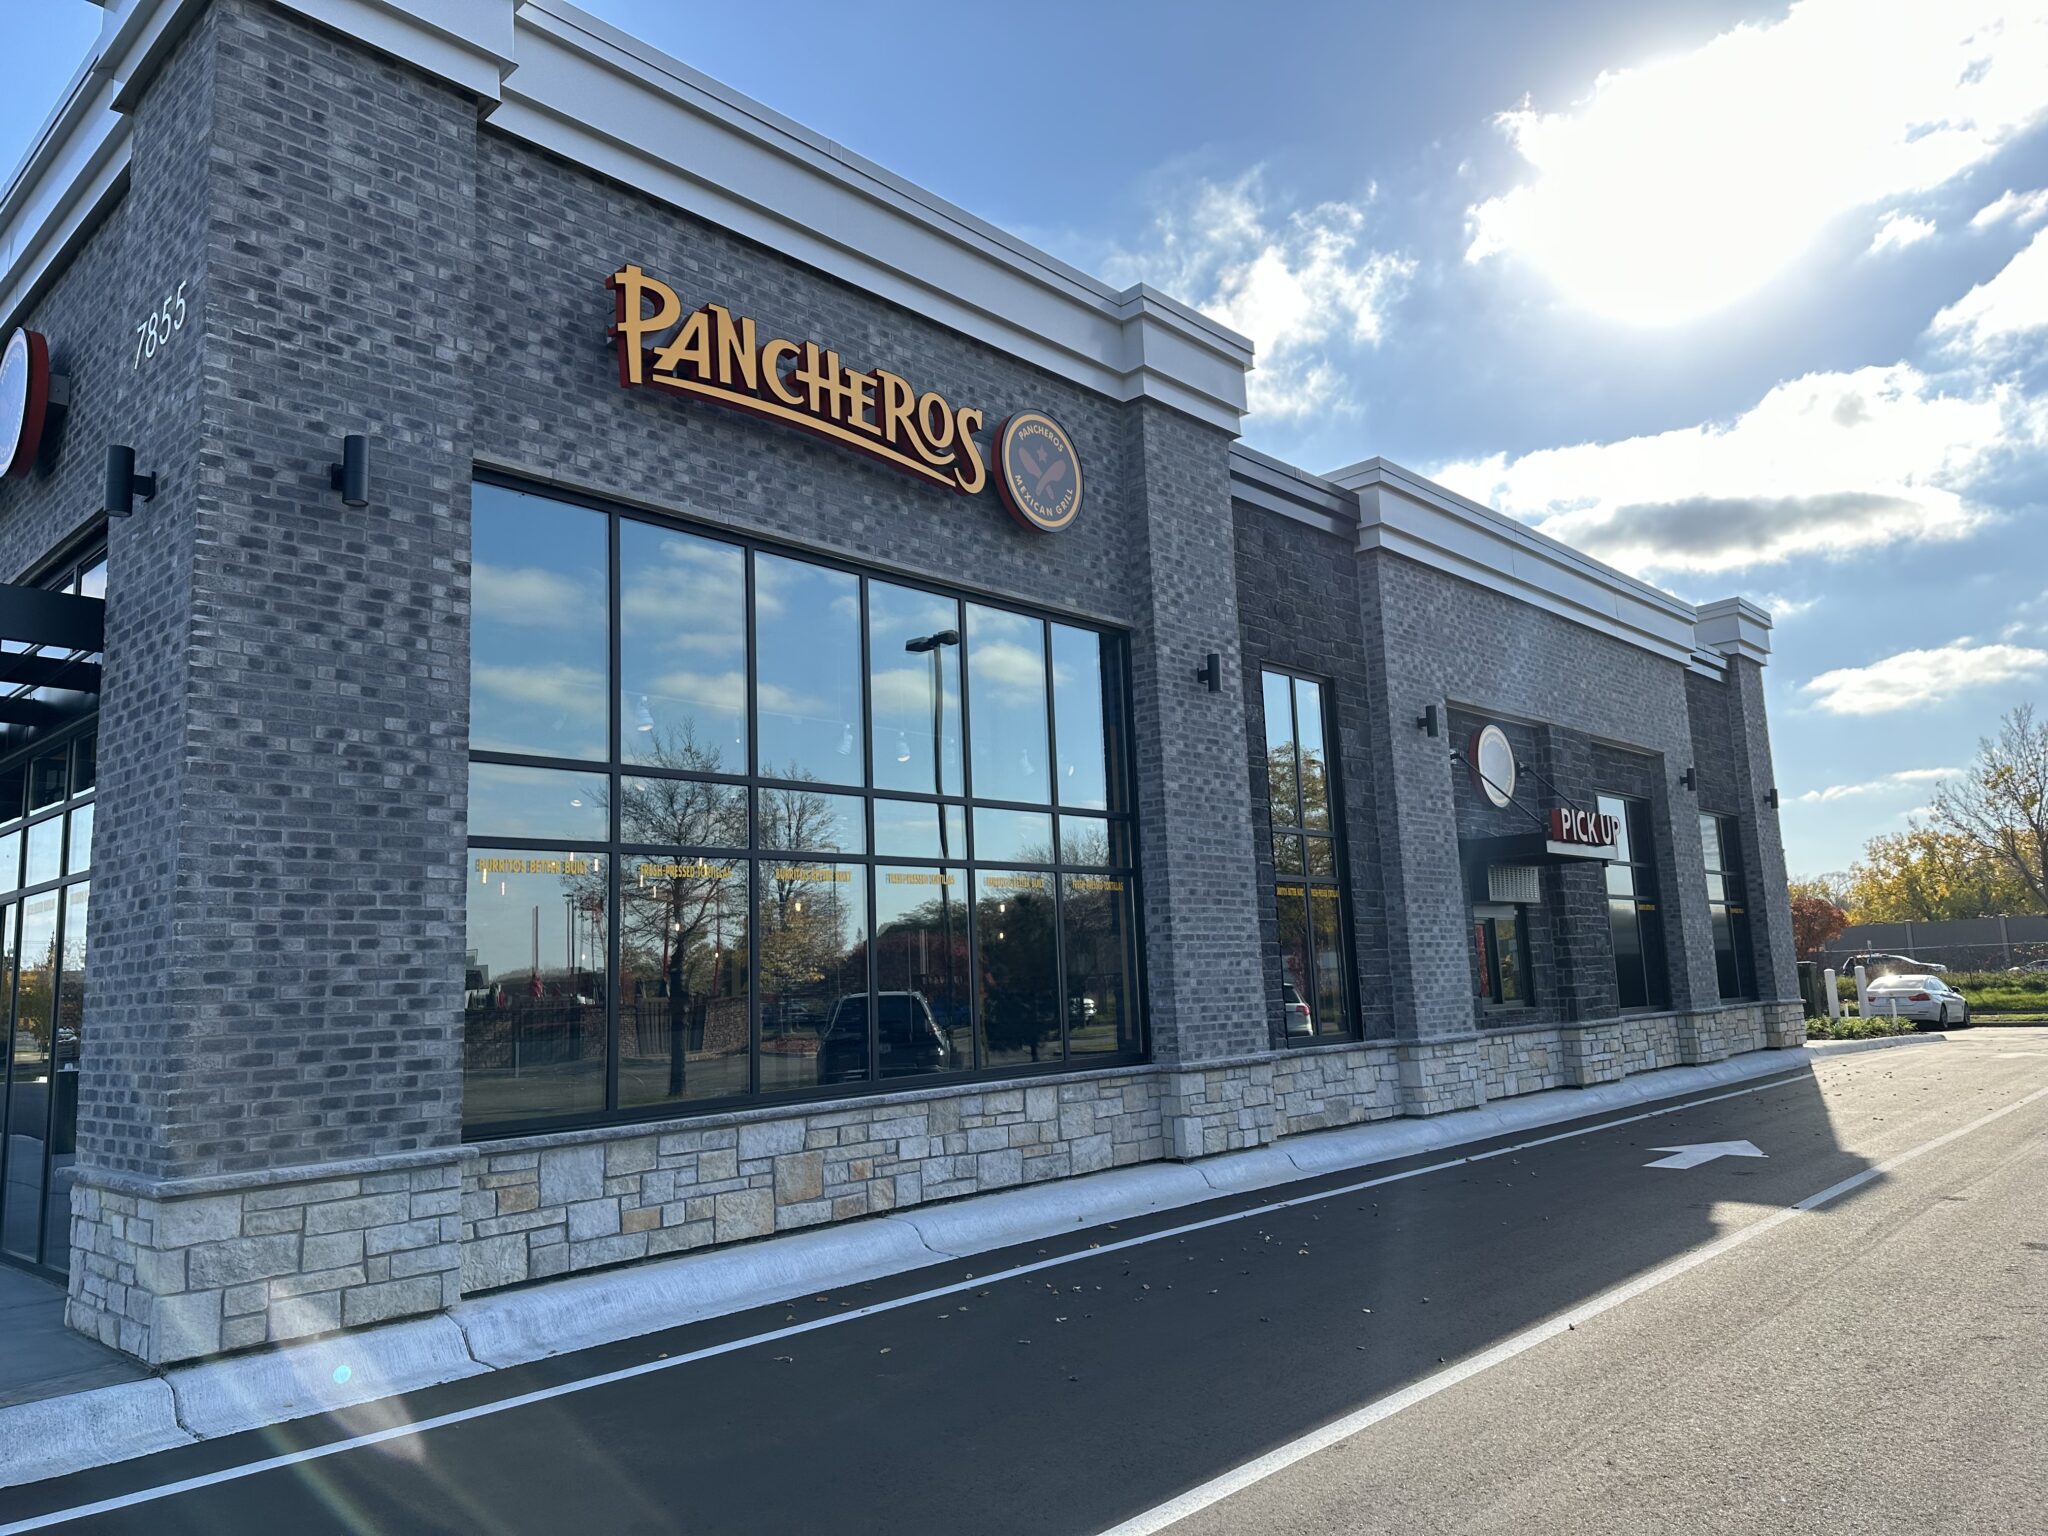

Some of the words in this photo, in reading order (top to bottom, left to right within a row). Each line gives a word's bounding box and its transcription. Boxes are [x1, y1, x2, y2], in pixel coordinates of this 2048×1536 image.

[134, 280, 187, 370] 7855
[609, 264, 986, 494] PANCHEROS
[1018, 424, 1064, 452] PANCHEROS
[1015, 474, 1053, 516] MEXICAN
[1055, 488, 1073, 514] GRILL
[1560, 808, 1600, 843] PICK
[1600, 814, 1620, 846] UP
